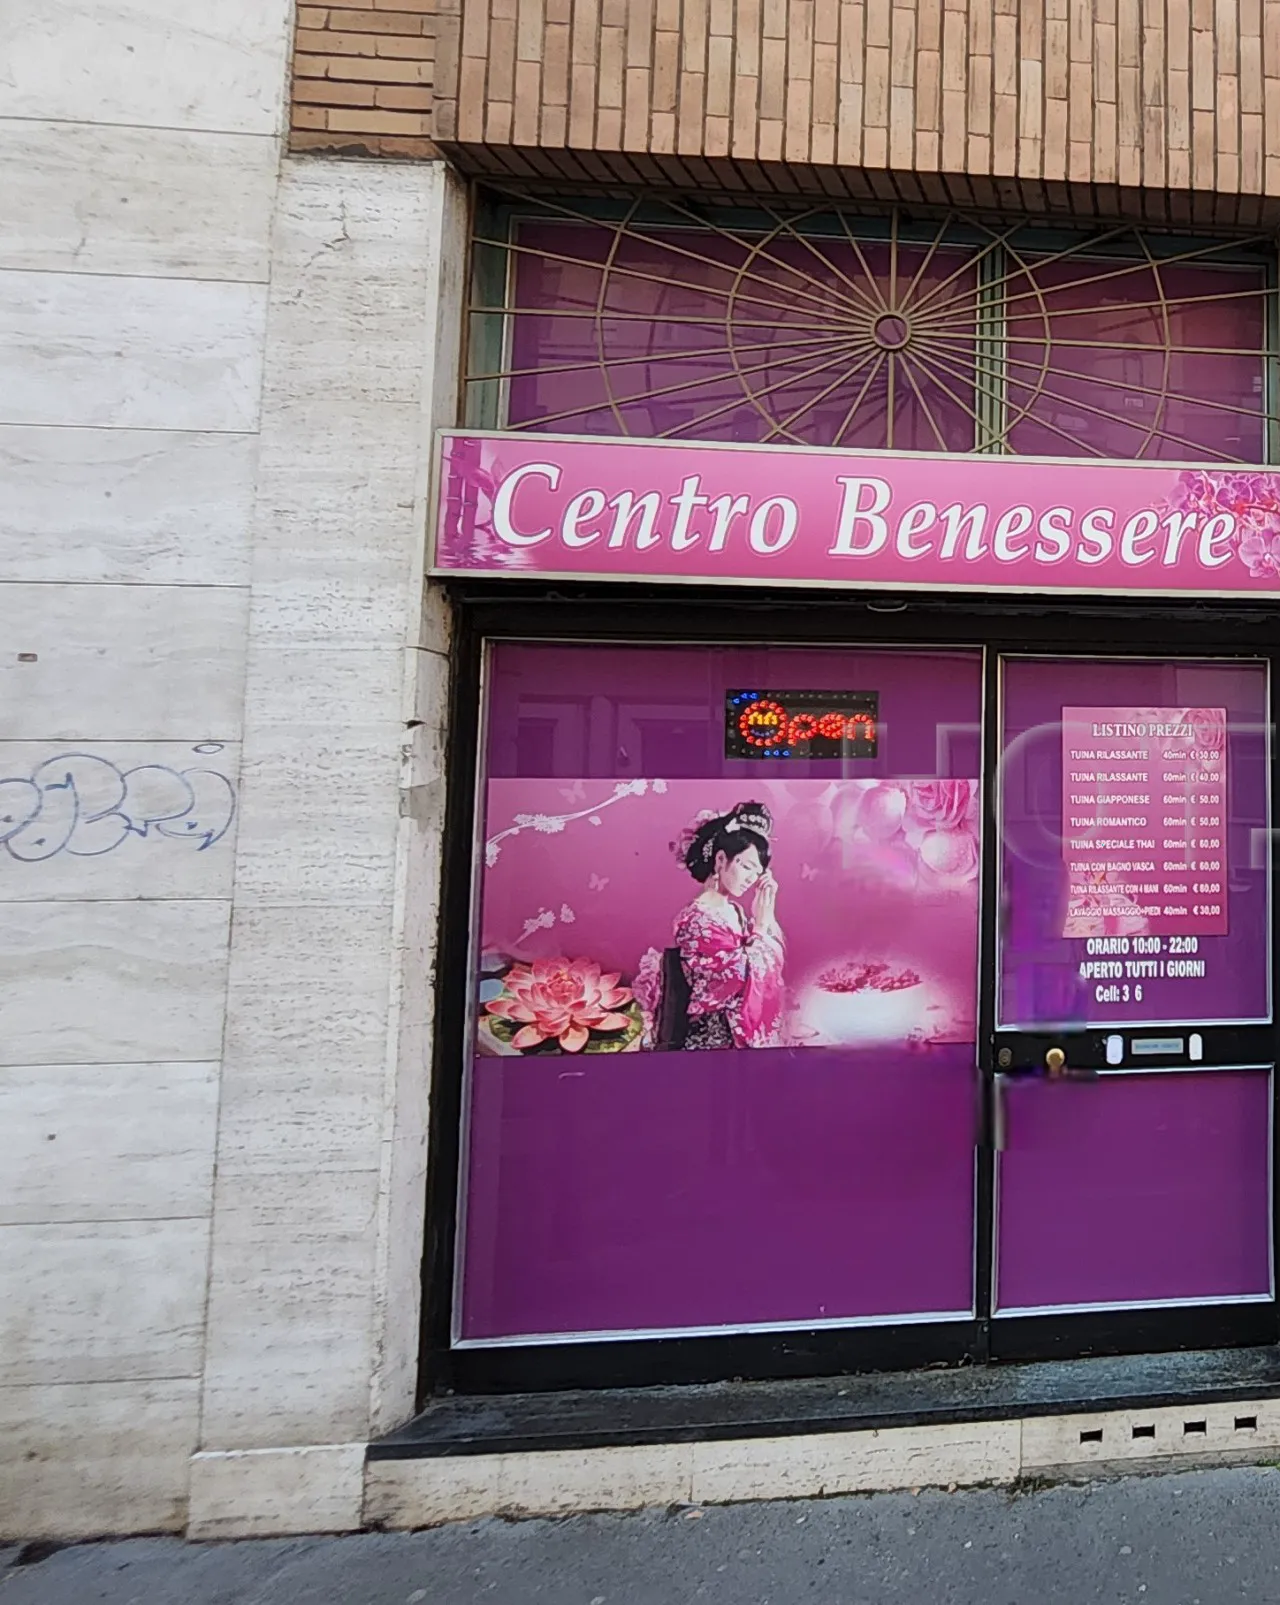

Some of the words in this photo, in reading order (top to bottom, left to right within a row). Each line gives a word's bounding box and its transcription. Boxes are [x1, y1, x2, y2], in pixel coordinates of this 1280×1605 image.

[490, 459, 800, 558] Centro
[827, 474, 1239, 569] Benessere
[739, 700, 875, 747] Open
[1092, 723, 1147, 737] LISTINO
[1148, 723, 1193, 737] PREZZI
[1070, 750, 1095, 760] TUINA
[1096, 750, 1149, 760] RILASSANTE
[1070, 772, 1095, 782] TUINA
[1096, 772, 1149, 782] RILASSANTE
[1070, 795, 1095, 804] TUINA
[1096, 795, 1150, 804] GIAPPONESE
[1070, 817, 1095, 827] TUINA
[1096, 817, 1147, 827] ROMANTICO
[1070, 840, 1095, 849] TUINA
[1095, 840, 1135, 849] SPECIALE
[1136, 840, 1155, 849] THAI
[1070, 862, 1090, 871] TUINA
[1091, 862, 1106, 871] CON
[1107, 862, 1132, 871] BAGNO
[1132, 862, 1155, 871] VASCA
[1086, 938, 1129, 955] ORARIO
[1132, 937, 1161, 954] 10:00
[1169, 936, 1198, 954] 22:00
[1079, 962, 1123, 979] APERTO
[1125, 961, 1157, 978] TUTTI
[1160, 961, 1164, 977] I
[1166, 960, 1205, 977] GIORNI
[1095, 985, 1120, 1002] Cell:
